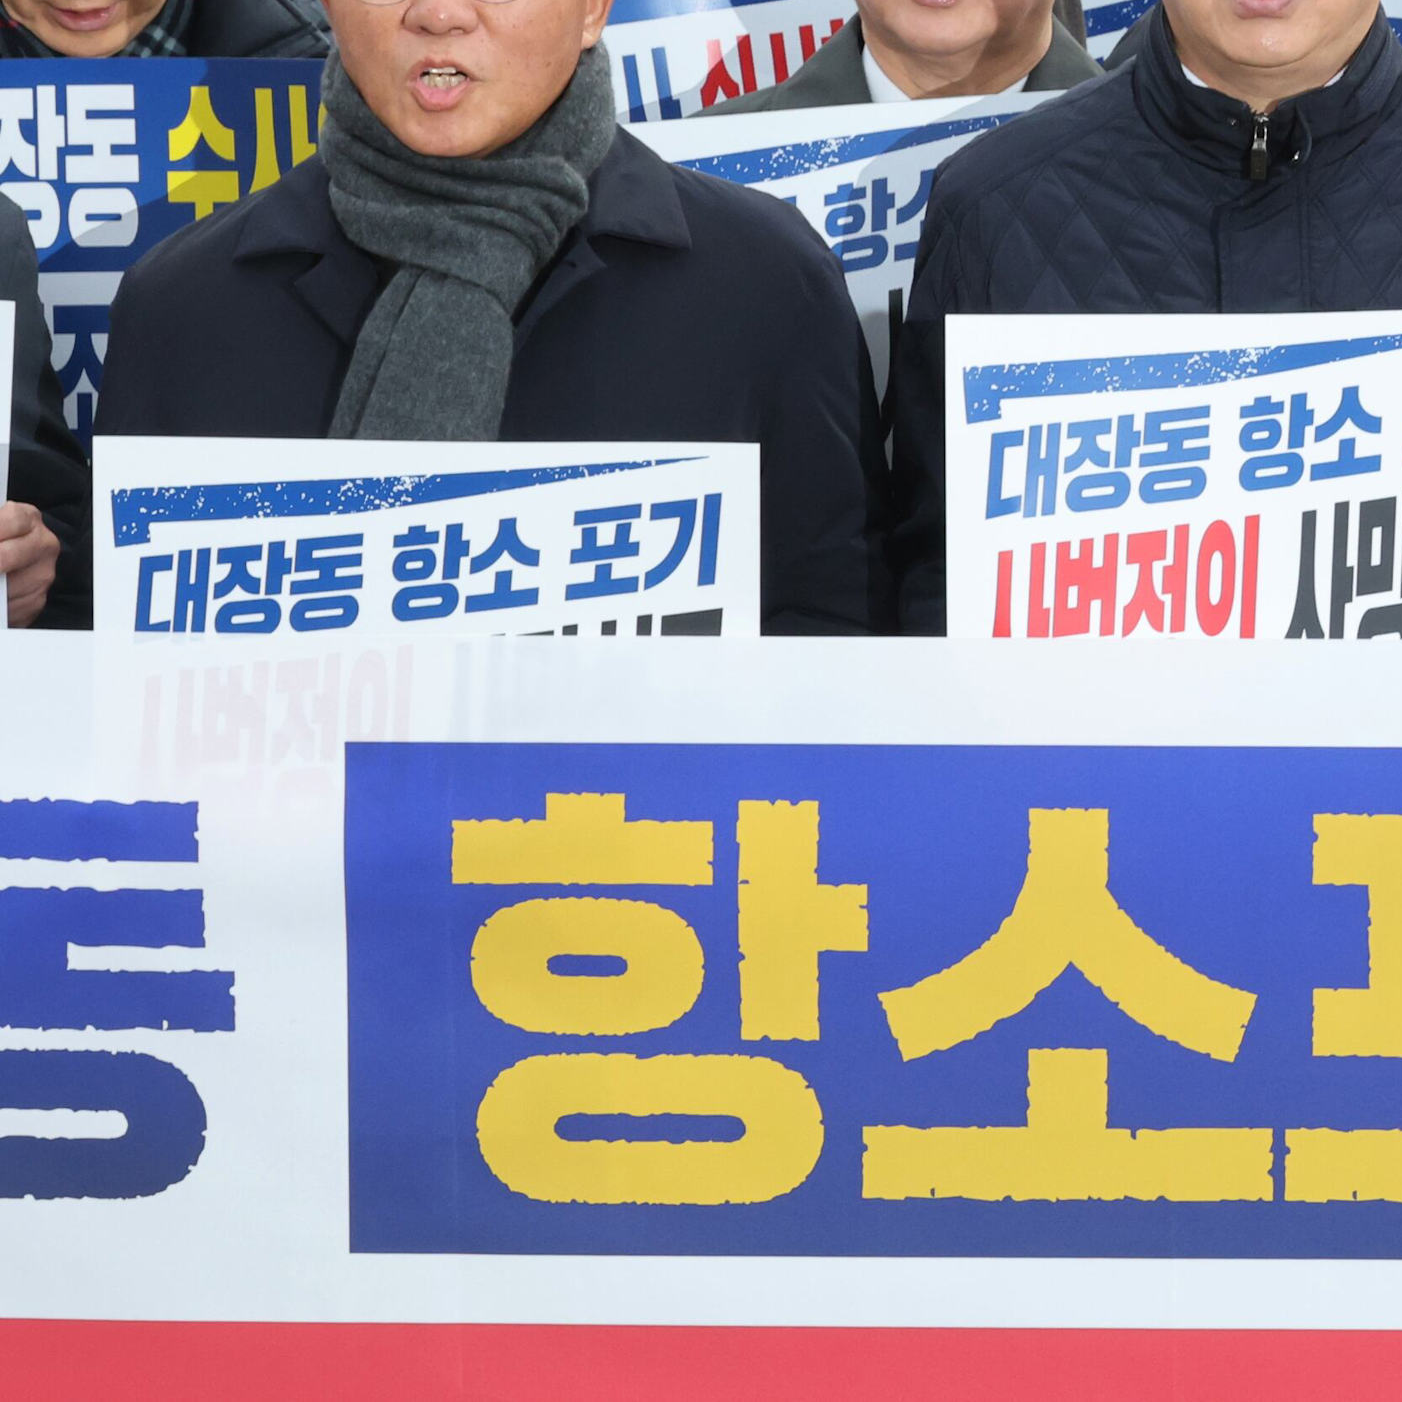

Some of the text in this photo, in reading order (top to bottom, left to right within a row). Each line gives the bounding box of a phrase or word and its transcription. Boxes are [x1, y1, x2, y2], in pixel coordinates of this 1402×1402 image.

[985, 405, 1211, 520] 대장동
[1238, 386, 1383, 492] 항소
[133, 493, 723, 636] 대장동 항소 포기
